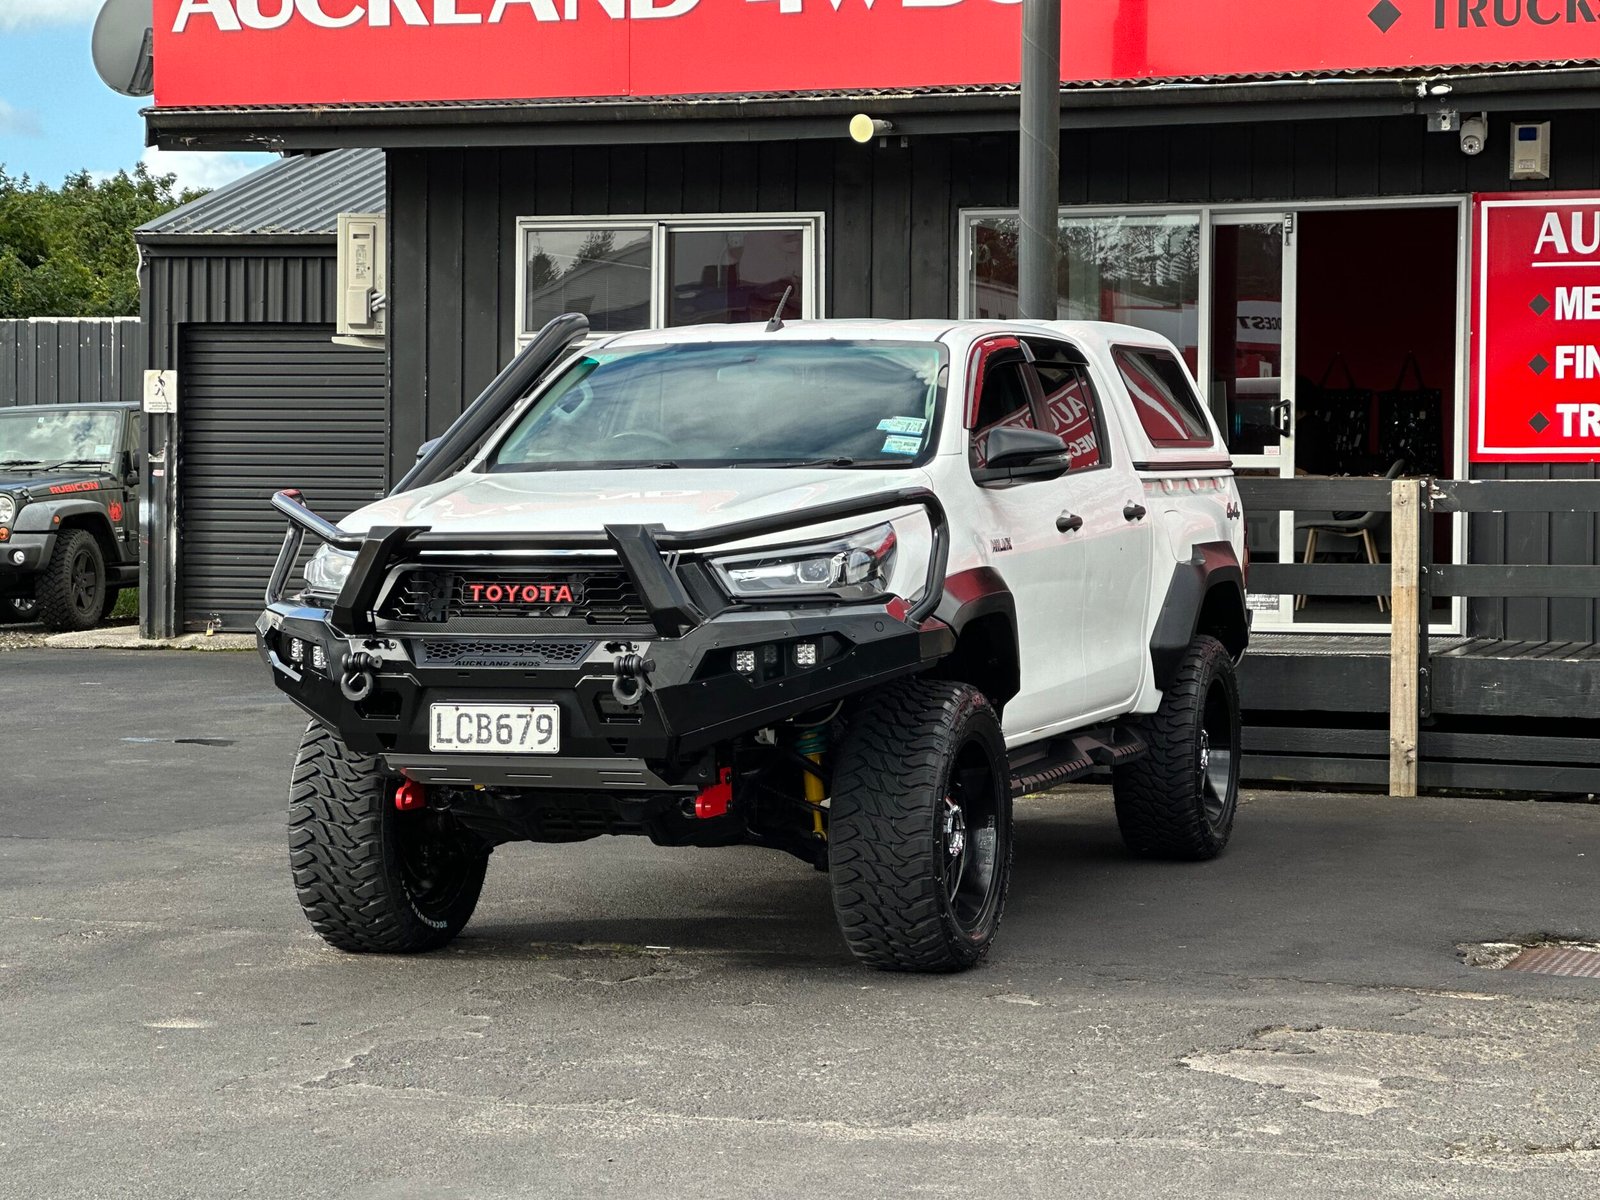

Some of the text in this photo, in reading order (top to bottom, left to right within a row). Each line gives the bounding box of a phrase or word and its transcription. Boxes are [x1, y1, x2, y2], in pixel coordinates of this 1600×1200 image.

[1434, 0, 1600, 29] TRUCK
[1555, 286, 1600, 320] ME
[1555, 345, 1600, 379] FIN
[1556, 403, 1600, 437] TR
[49, 481, 99, 494] RUBICON
[470, 584, 574, 603] TOYOTA
[436, 712, 553, 745] LCB679
